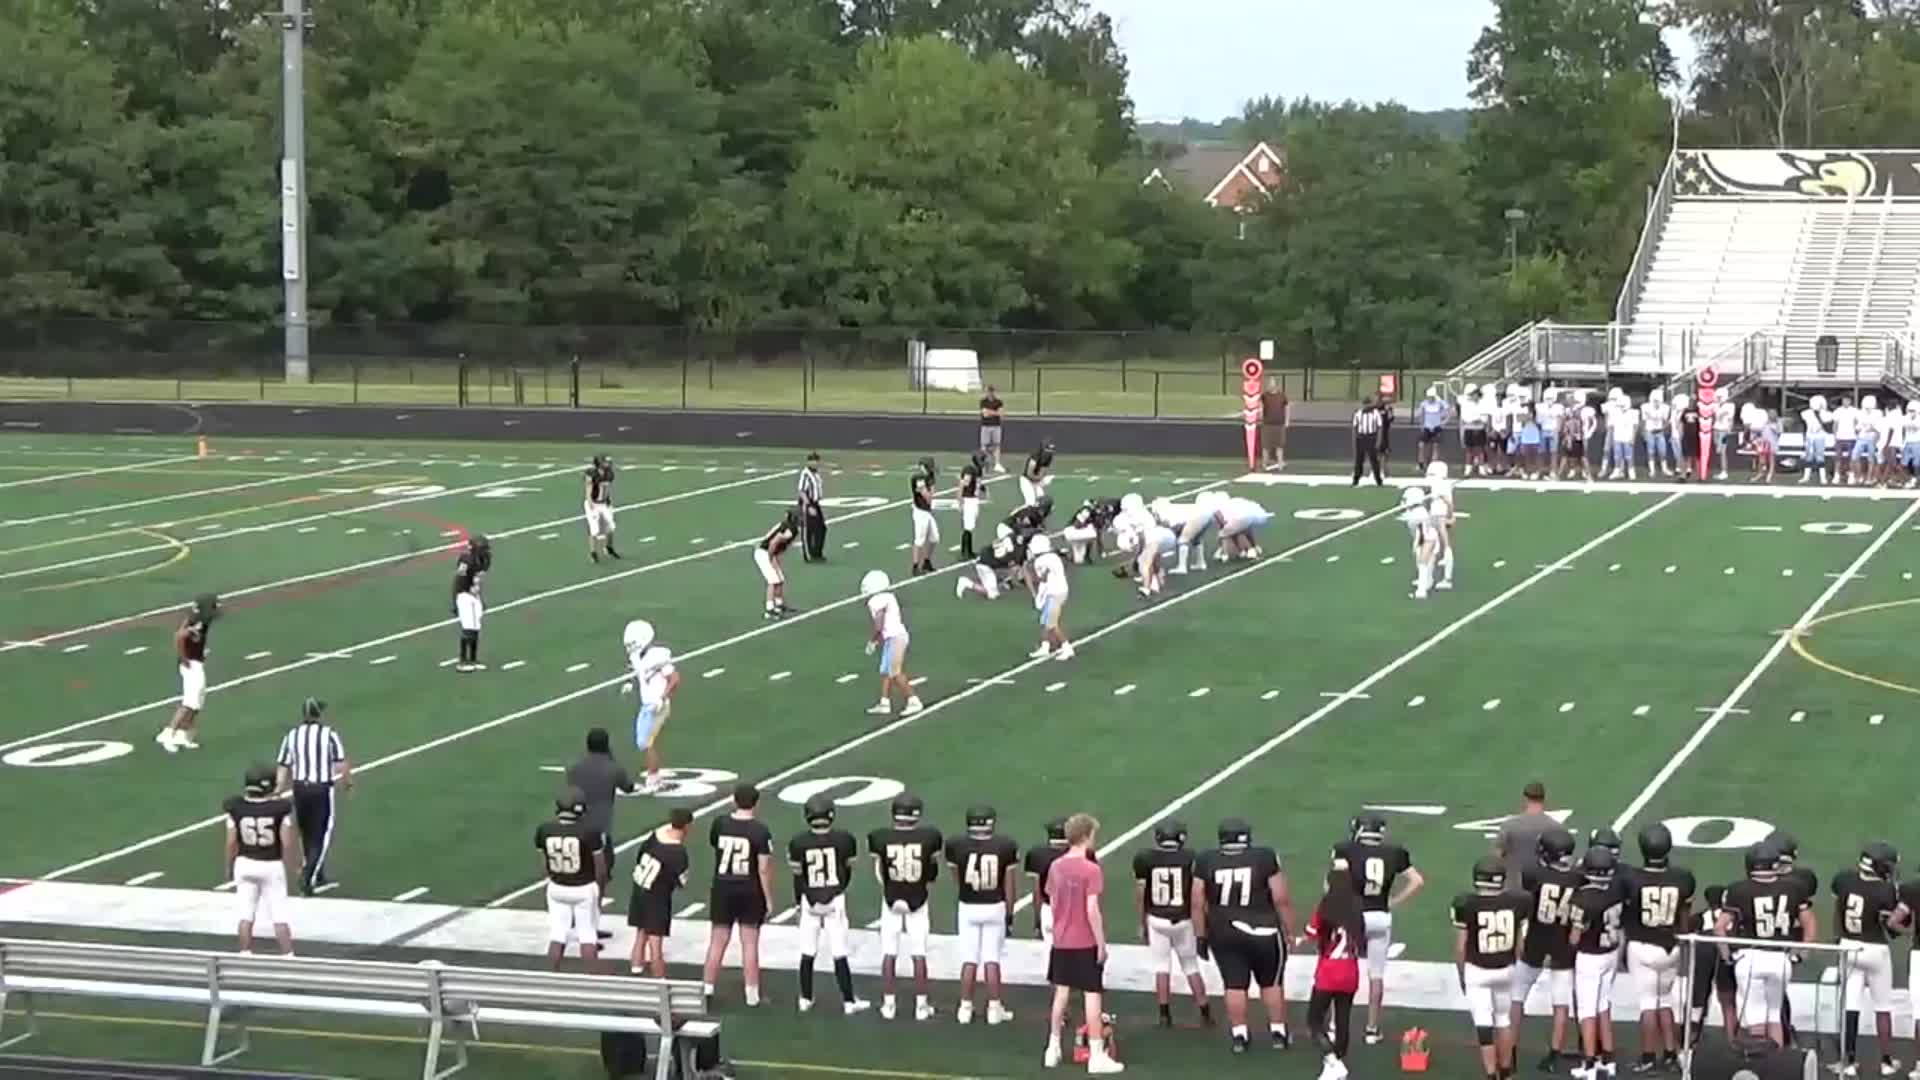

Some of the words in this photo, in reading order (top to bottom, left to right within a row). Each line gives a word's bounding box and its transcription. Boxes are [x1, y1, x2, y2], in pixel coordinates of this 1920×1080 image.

[239, 815, 276, 847] 65
[545, 836, 581, 874] 59
[718, 835, 751, 875] 72
[805, 847, 840, 888] 21
[886, 842, 922, 882] 36
[964, 852, 999, 891] 40
[1150, 867, 1183, 907] 61
[1214, 866, 1252, 907] 77
[1363, 857, 1385, 896] 9
[1536, 883, 1574, 926] 64
[1640, 886, 1680, 927] 50
[1752, 895, 1790, 938] 54
[1844, 892, 1865, 934] 2
[1477, 909, 1515, 954] 29
